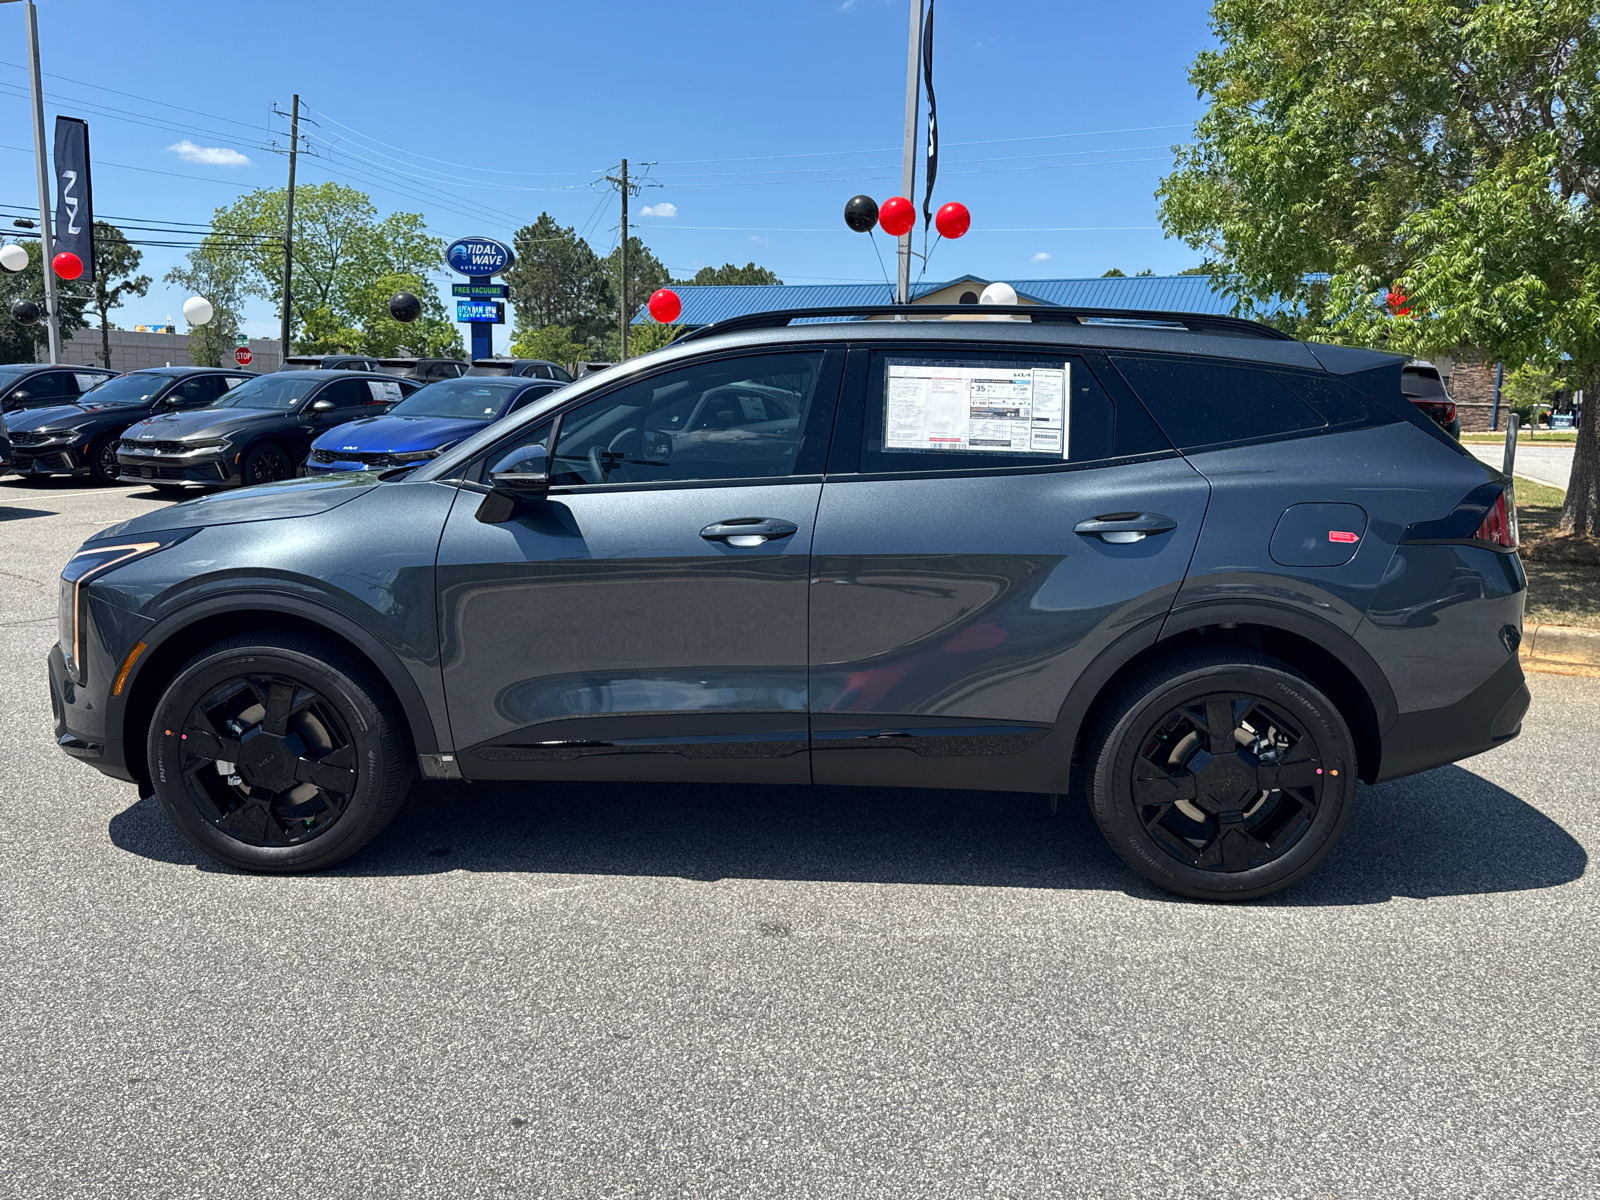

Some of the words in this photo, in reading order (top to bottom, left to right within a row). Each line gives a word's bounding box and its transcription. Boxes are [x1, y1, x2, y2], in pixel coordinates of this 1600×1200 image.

[467, 244, 497, 255] TIDAL
[472, 255, 503, 265] WAVE
[236, 352, 252, 360] STOP
